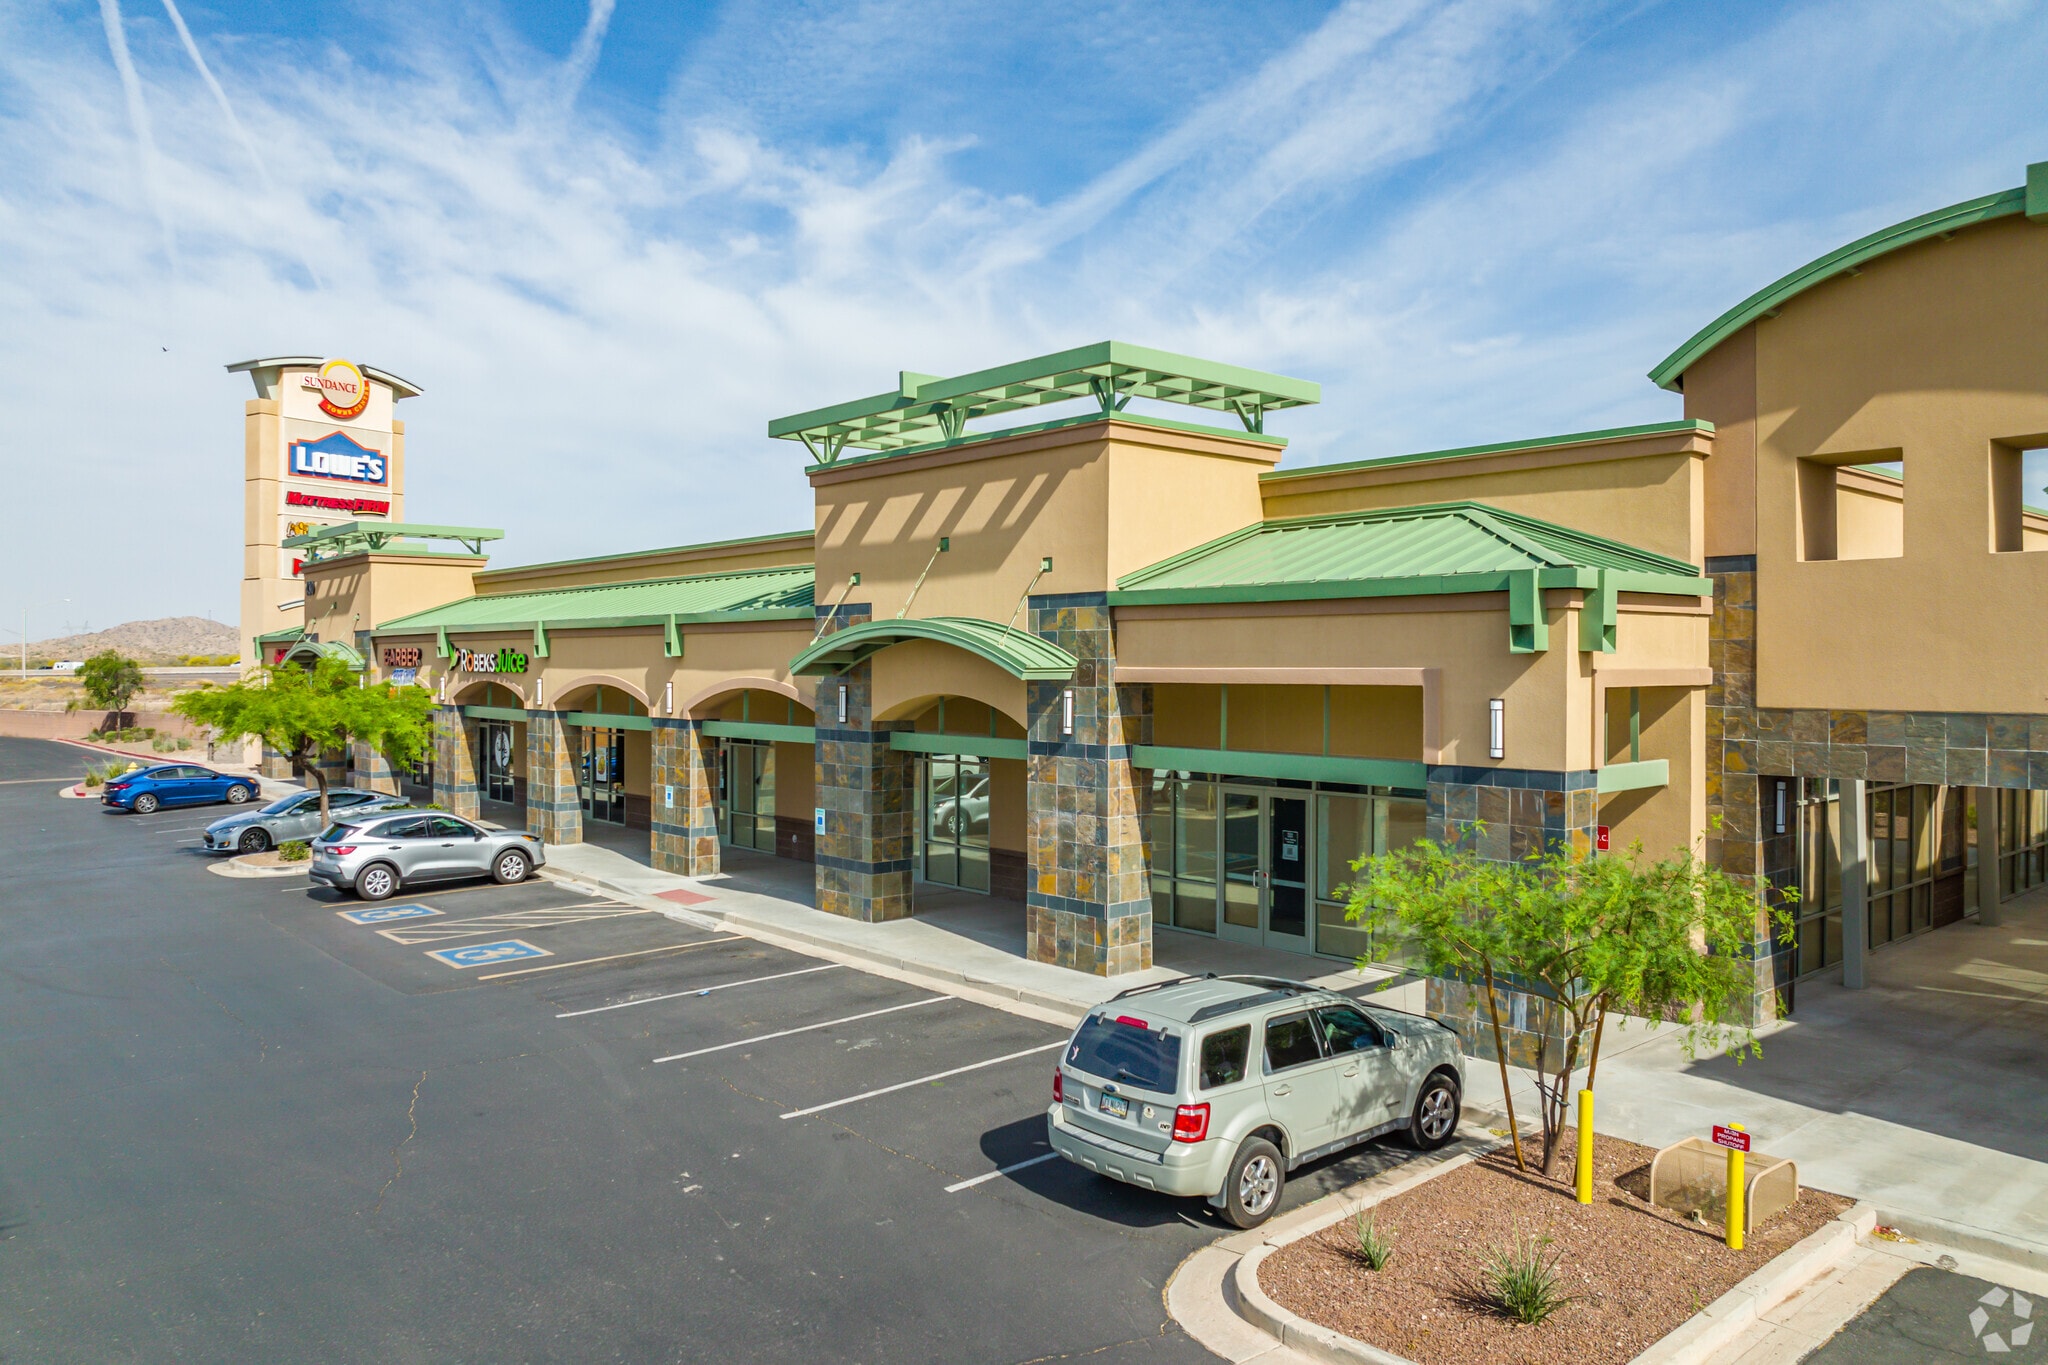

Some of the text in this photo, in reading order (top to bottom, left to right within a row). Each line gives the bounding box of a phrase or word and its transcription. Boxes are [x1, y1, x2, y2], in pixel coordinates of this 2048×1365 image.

[304, 375, 357, 394] SUNDANCE
[296, 446, 383, 480] LOWE'S
[384, 648, 419, 666] BARBER
[1717, 1132, 1745, 1144] PROPANE
